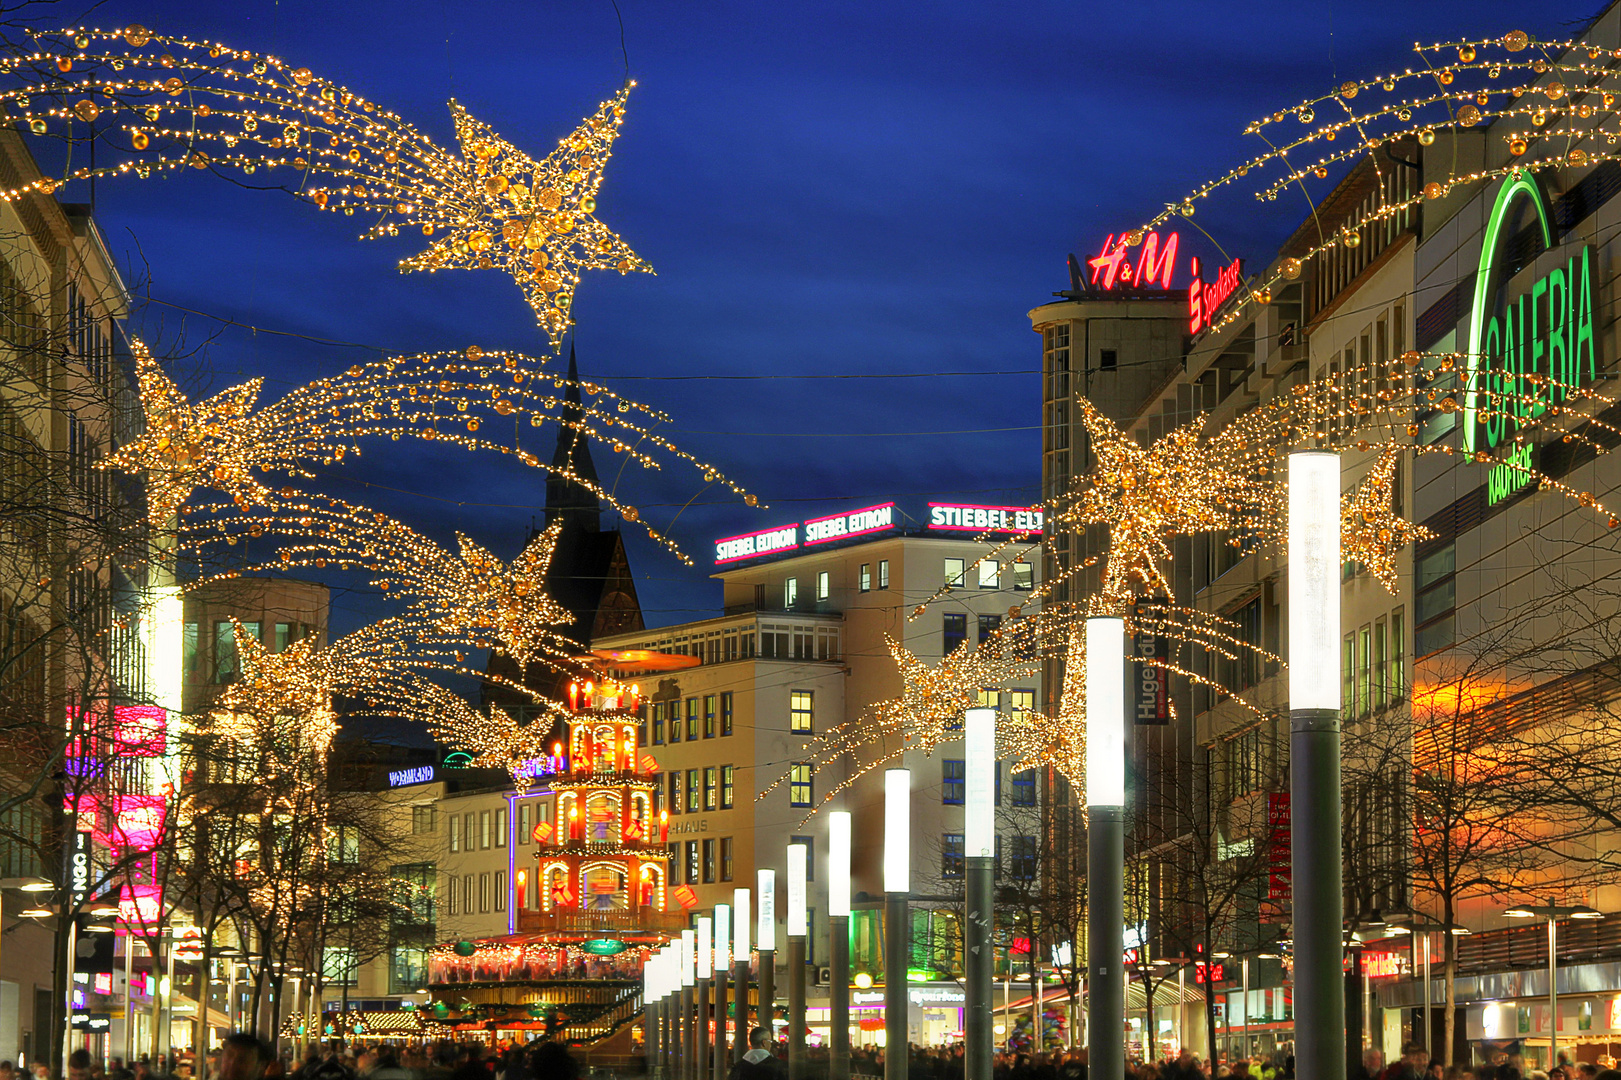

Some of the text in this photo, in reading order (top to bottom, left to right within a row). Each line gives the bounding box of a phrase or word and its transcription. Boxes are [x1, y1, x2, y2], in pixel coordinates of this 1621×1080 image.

[1088, 232, 1179, 290] H&M
[1203, 257, 1240, 327] Sparkasse
[1486, 245, 1596, 448] GALERIA
[806, 506, 891, 542] STIEBEL ELTRON
[931, 506, 1007, 528] STIEBEL
[716, 528, 796, 560] STIEBEL ELTRON
